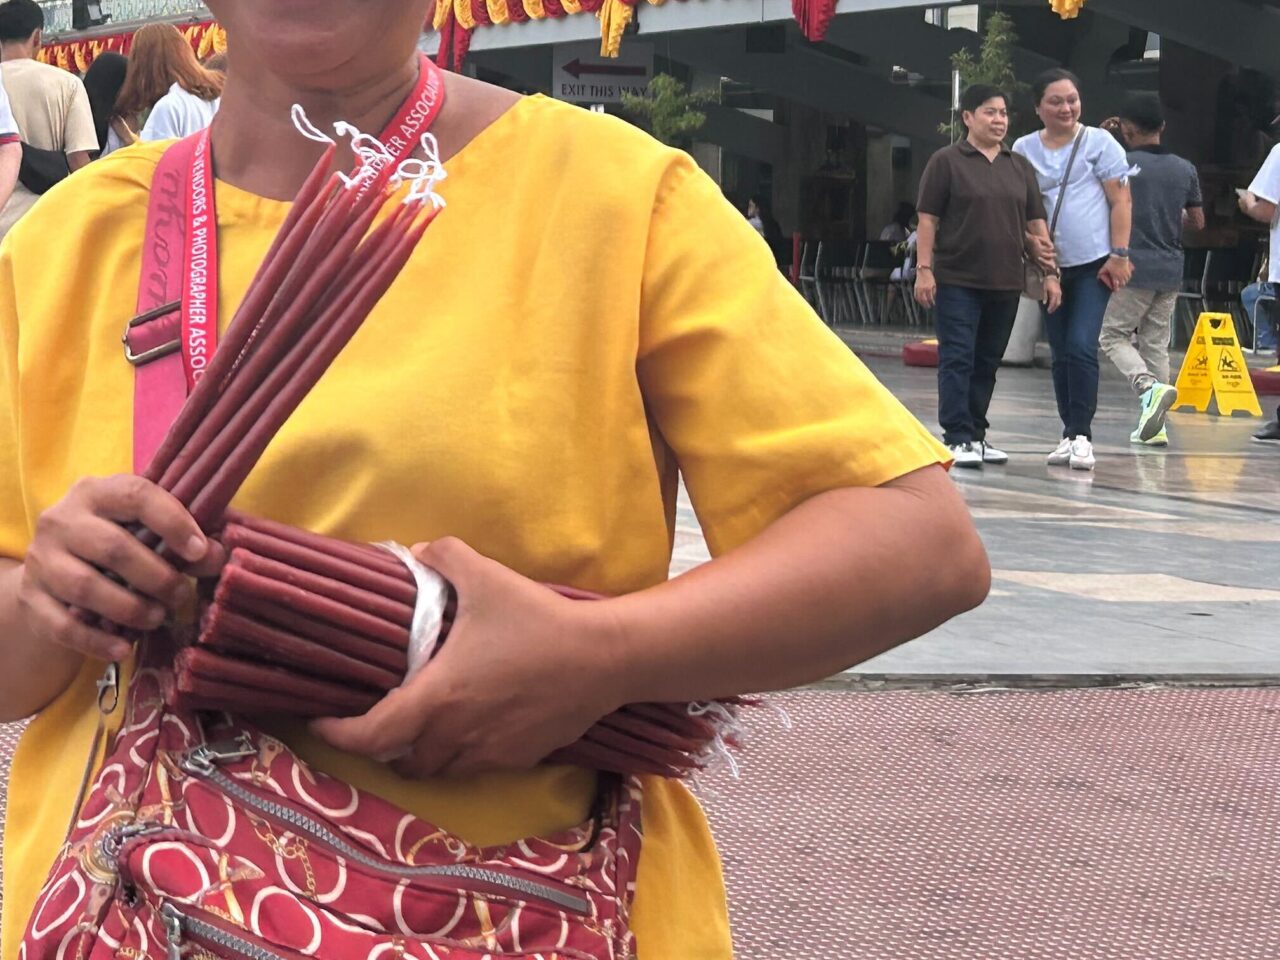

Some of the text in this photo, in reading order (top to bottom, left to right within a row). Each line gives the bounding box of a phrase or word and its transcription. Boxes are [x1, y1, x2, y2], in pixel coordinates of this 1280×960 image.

[561, 83, 585, 96] EXIT
[590, 84, 614, 97] THIS
[192, 153, 207, 215] VENDORS
[192, 214, 208, 228] &
[189, 227, 208, 324] PHOTOGRAPHER
[189, 327, 207, 384] ASSOC
